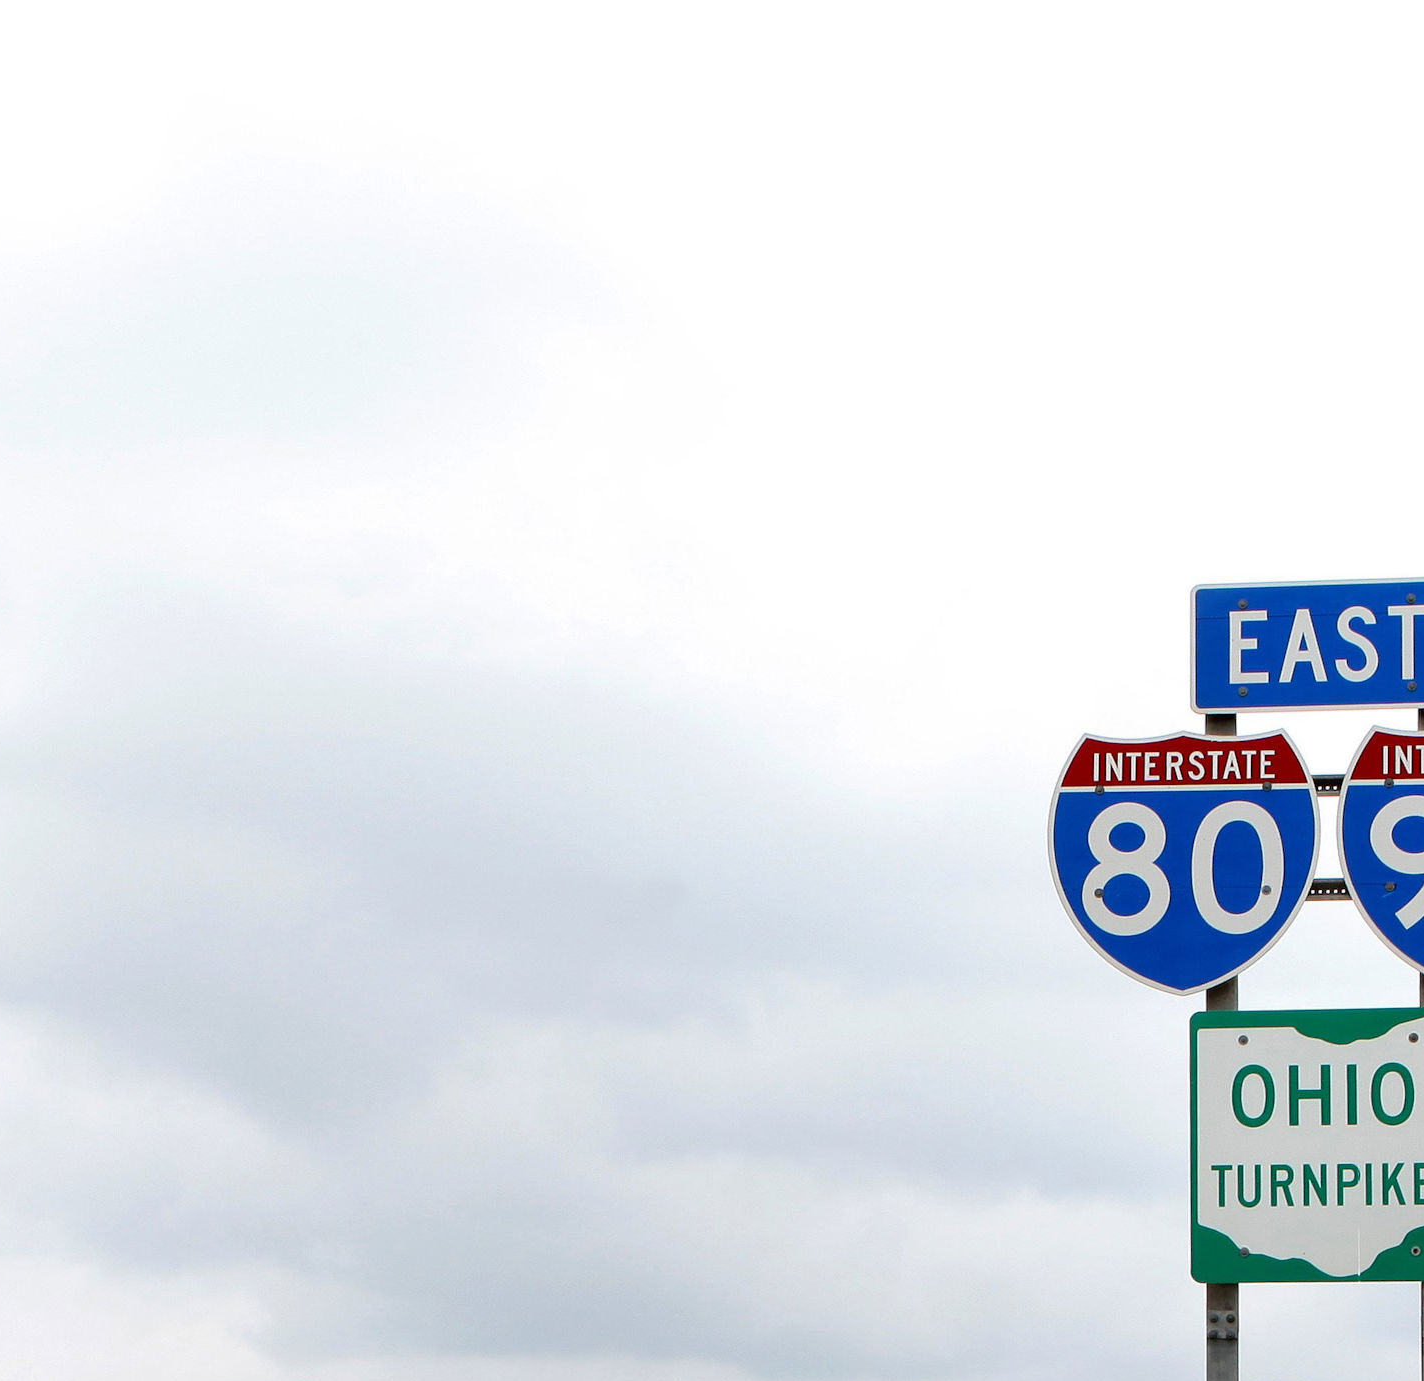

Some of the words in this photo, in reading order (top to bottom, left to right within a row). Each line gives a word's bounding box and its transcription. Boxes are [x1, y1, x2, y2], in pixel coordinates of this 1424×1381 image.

[1092, 748, 1276, 782] INTERSTATE
[1081, 801, 1285, 936] 80
[1231, 1062, 1415, 1128] OHIO
